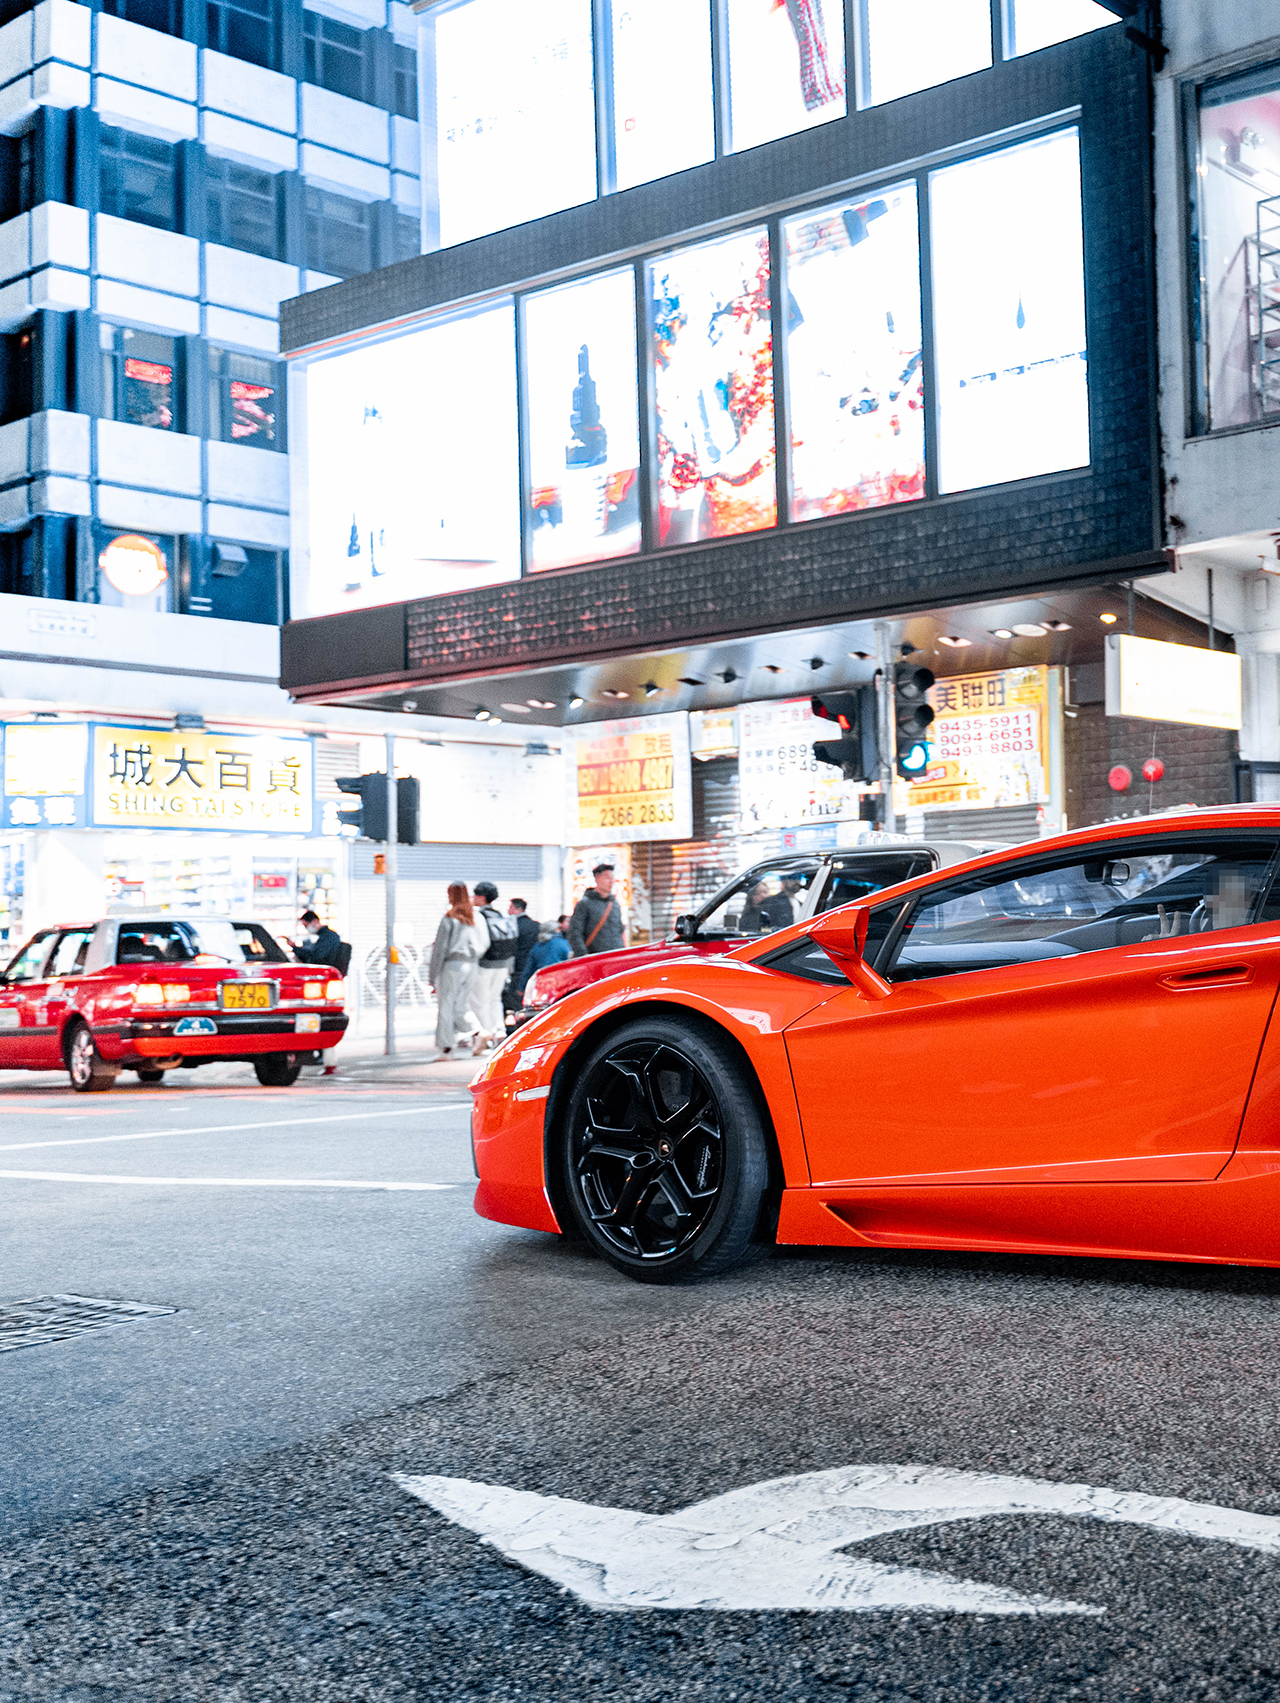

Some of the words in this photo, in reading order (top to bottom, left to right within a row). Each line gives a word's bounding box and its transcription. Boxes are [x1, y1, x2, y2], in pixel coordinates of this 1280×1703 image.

[939, 713, 1032, 733] 9435-5911
[940, 727, 1033, 746] 9094-6651
[778, 744, 815, 759] 689
[108, 793, 183, 813] SHING
[600, 806, 634, 826] 2366
[640, 803, 674, 823] 2833
